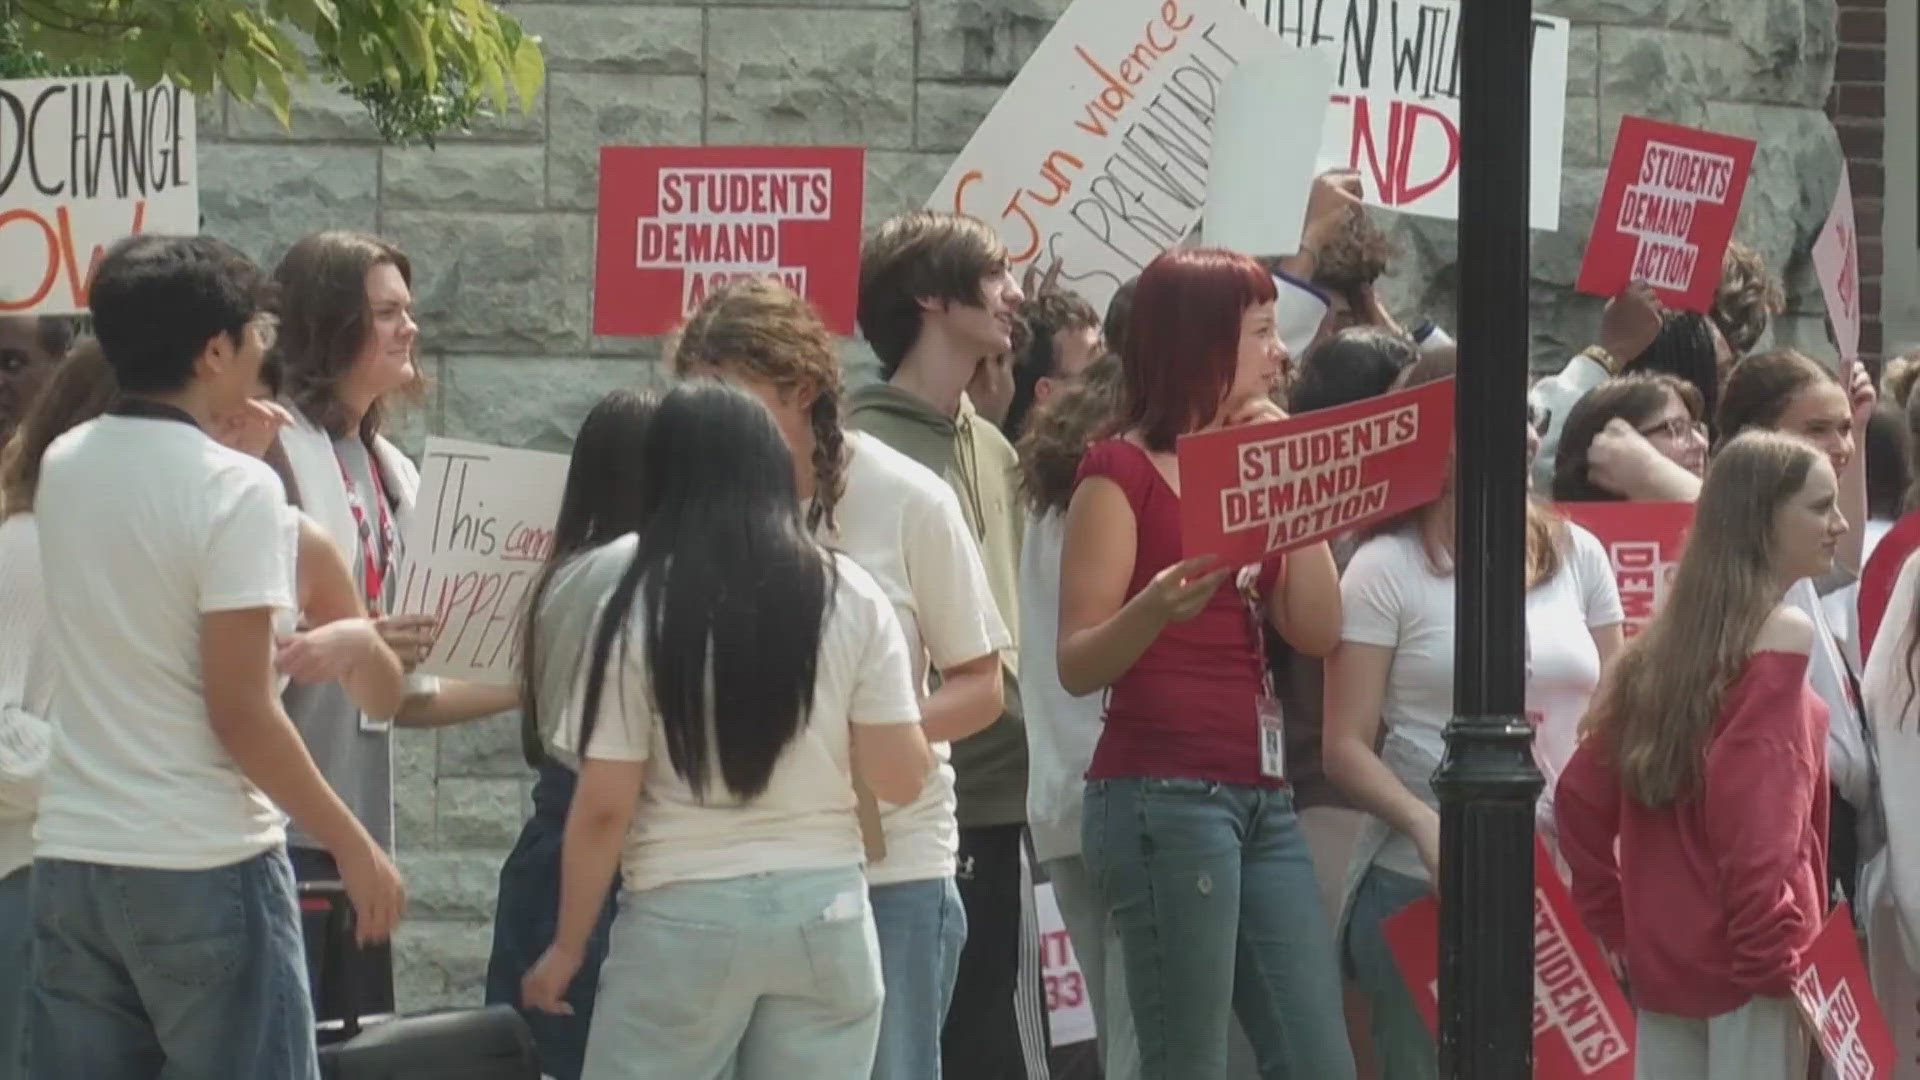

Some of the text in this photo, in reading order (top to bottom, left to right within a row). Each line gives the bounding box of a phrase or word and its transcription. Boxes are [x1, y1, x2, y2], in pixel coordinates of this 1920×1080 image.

[1073, 0, 1195, 138] violence
[1238, 0, 1378, 88] HEN
[1328, 95, 1461, 206] ND
[1641, 147, 1732, 199] STUDENTS
[661, 173, 829, 215] STUDENTS
[1620, 190, 1693, 236] DEMAND
[641, 223, 776, 263] DEMAND
[1633, 240, 1697, 285] ACTION
[1242, 410, 1415, 482] STUDENTS
[430, 452, 496, 555] This
[1225, 463, 1358, 528] DEMAND
[1270, 484, 1385, 551] ACTION
[1536, 900, 1622, 1069] TUDENTS
